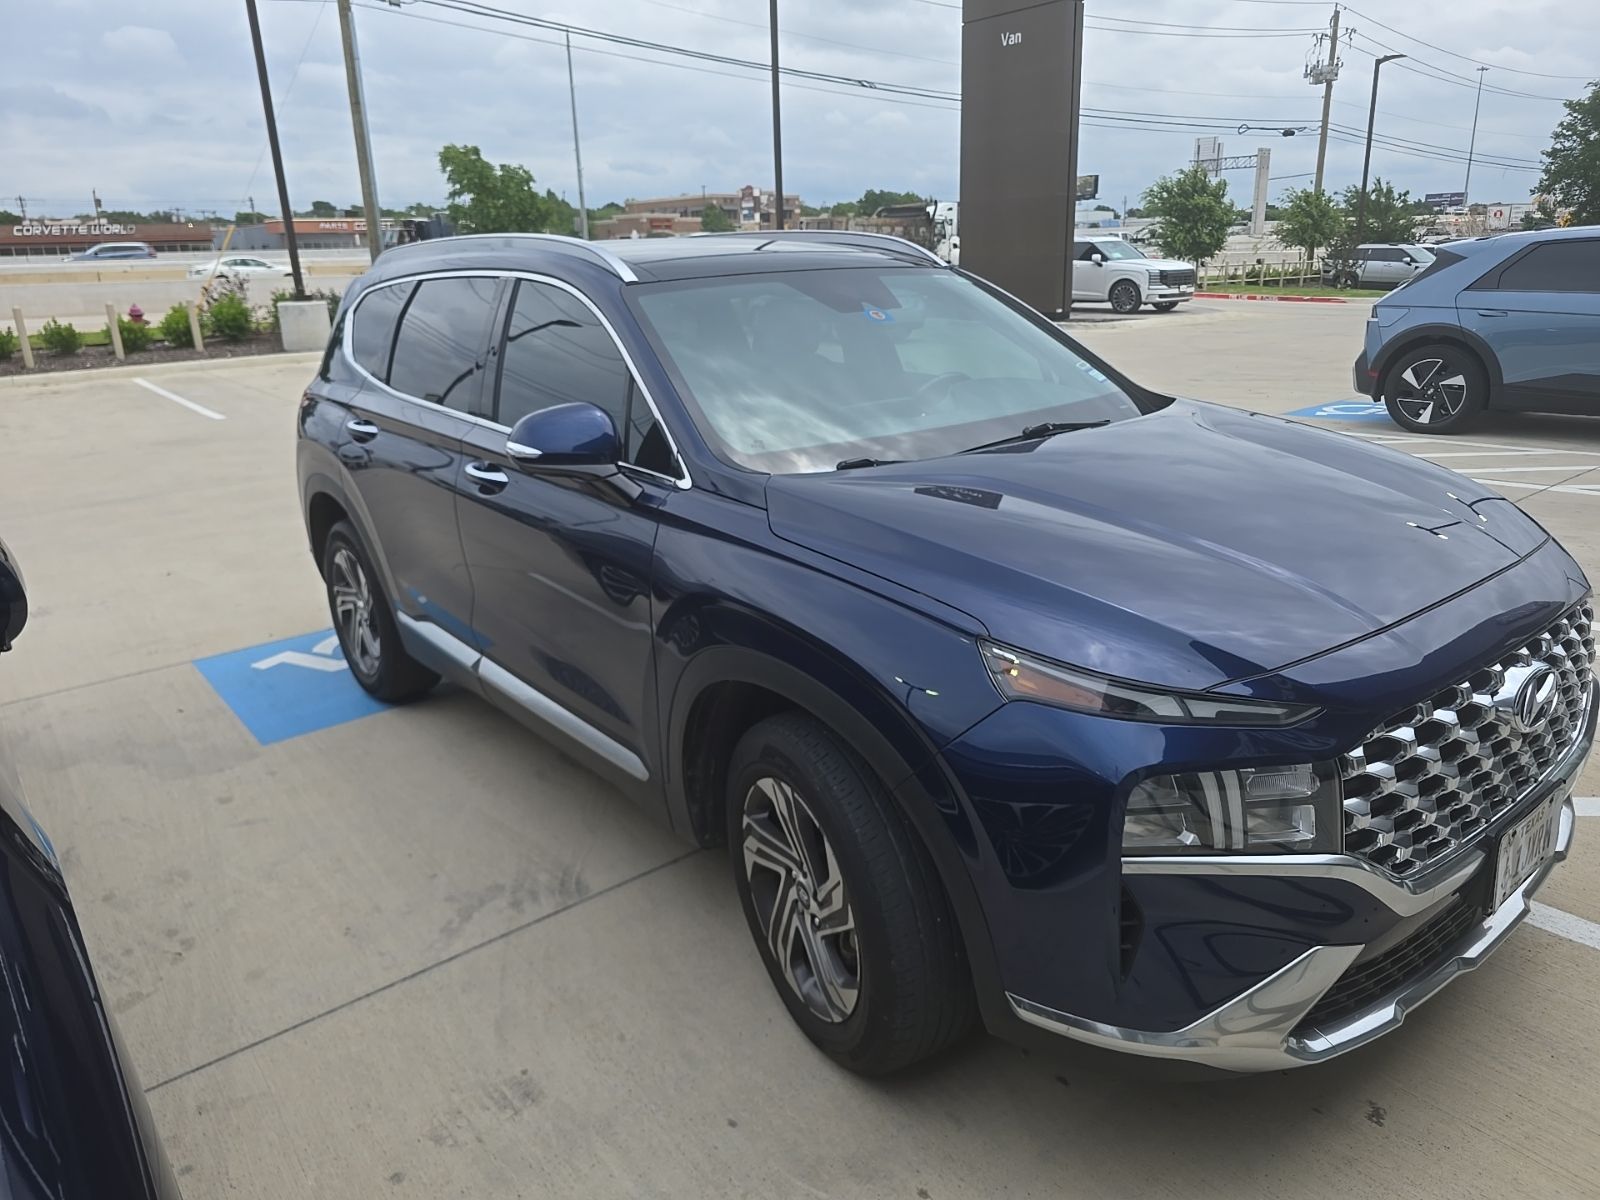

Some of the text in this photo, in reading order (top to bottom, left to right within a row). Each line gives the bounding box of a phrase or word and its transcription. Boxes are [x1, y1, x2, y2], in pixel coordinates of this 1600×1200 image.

[1001, 32, 1022, 47] Van
[13, 223, 136, 236] CORVETTE WORLD
[1520, 806, 1546, 838] TEXAS
